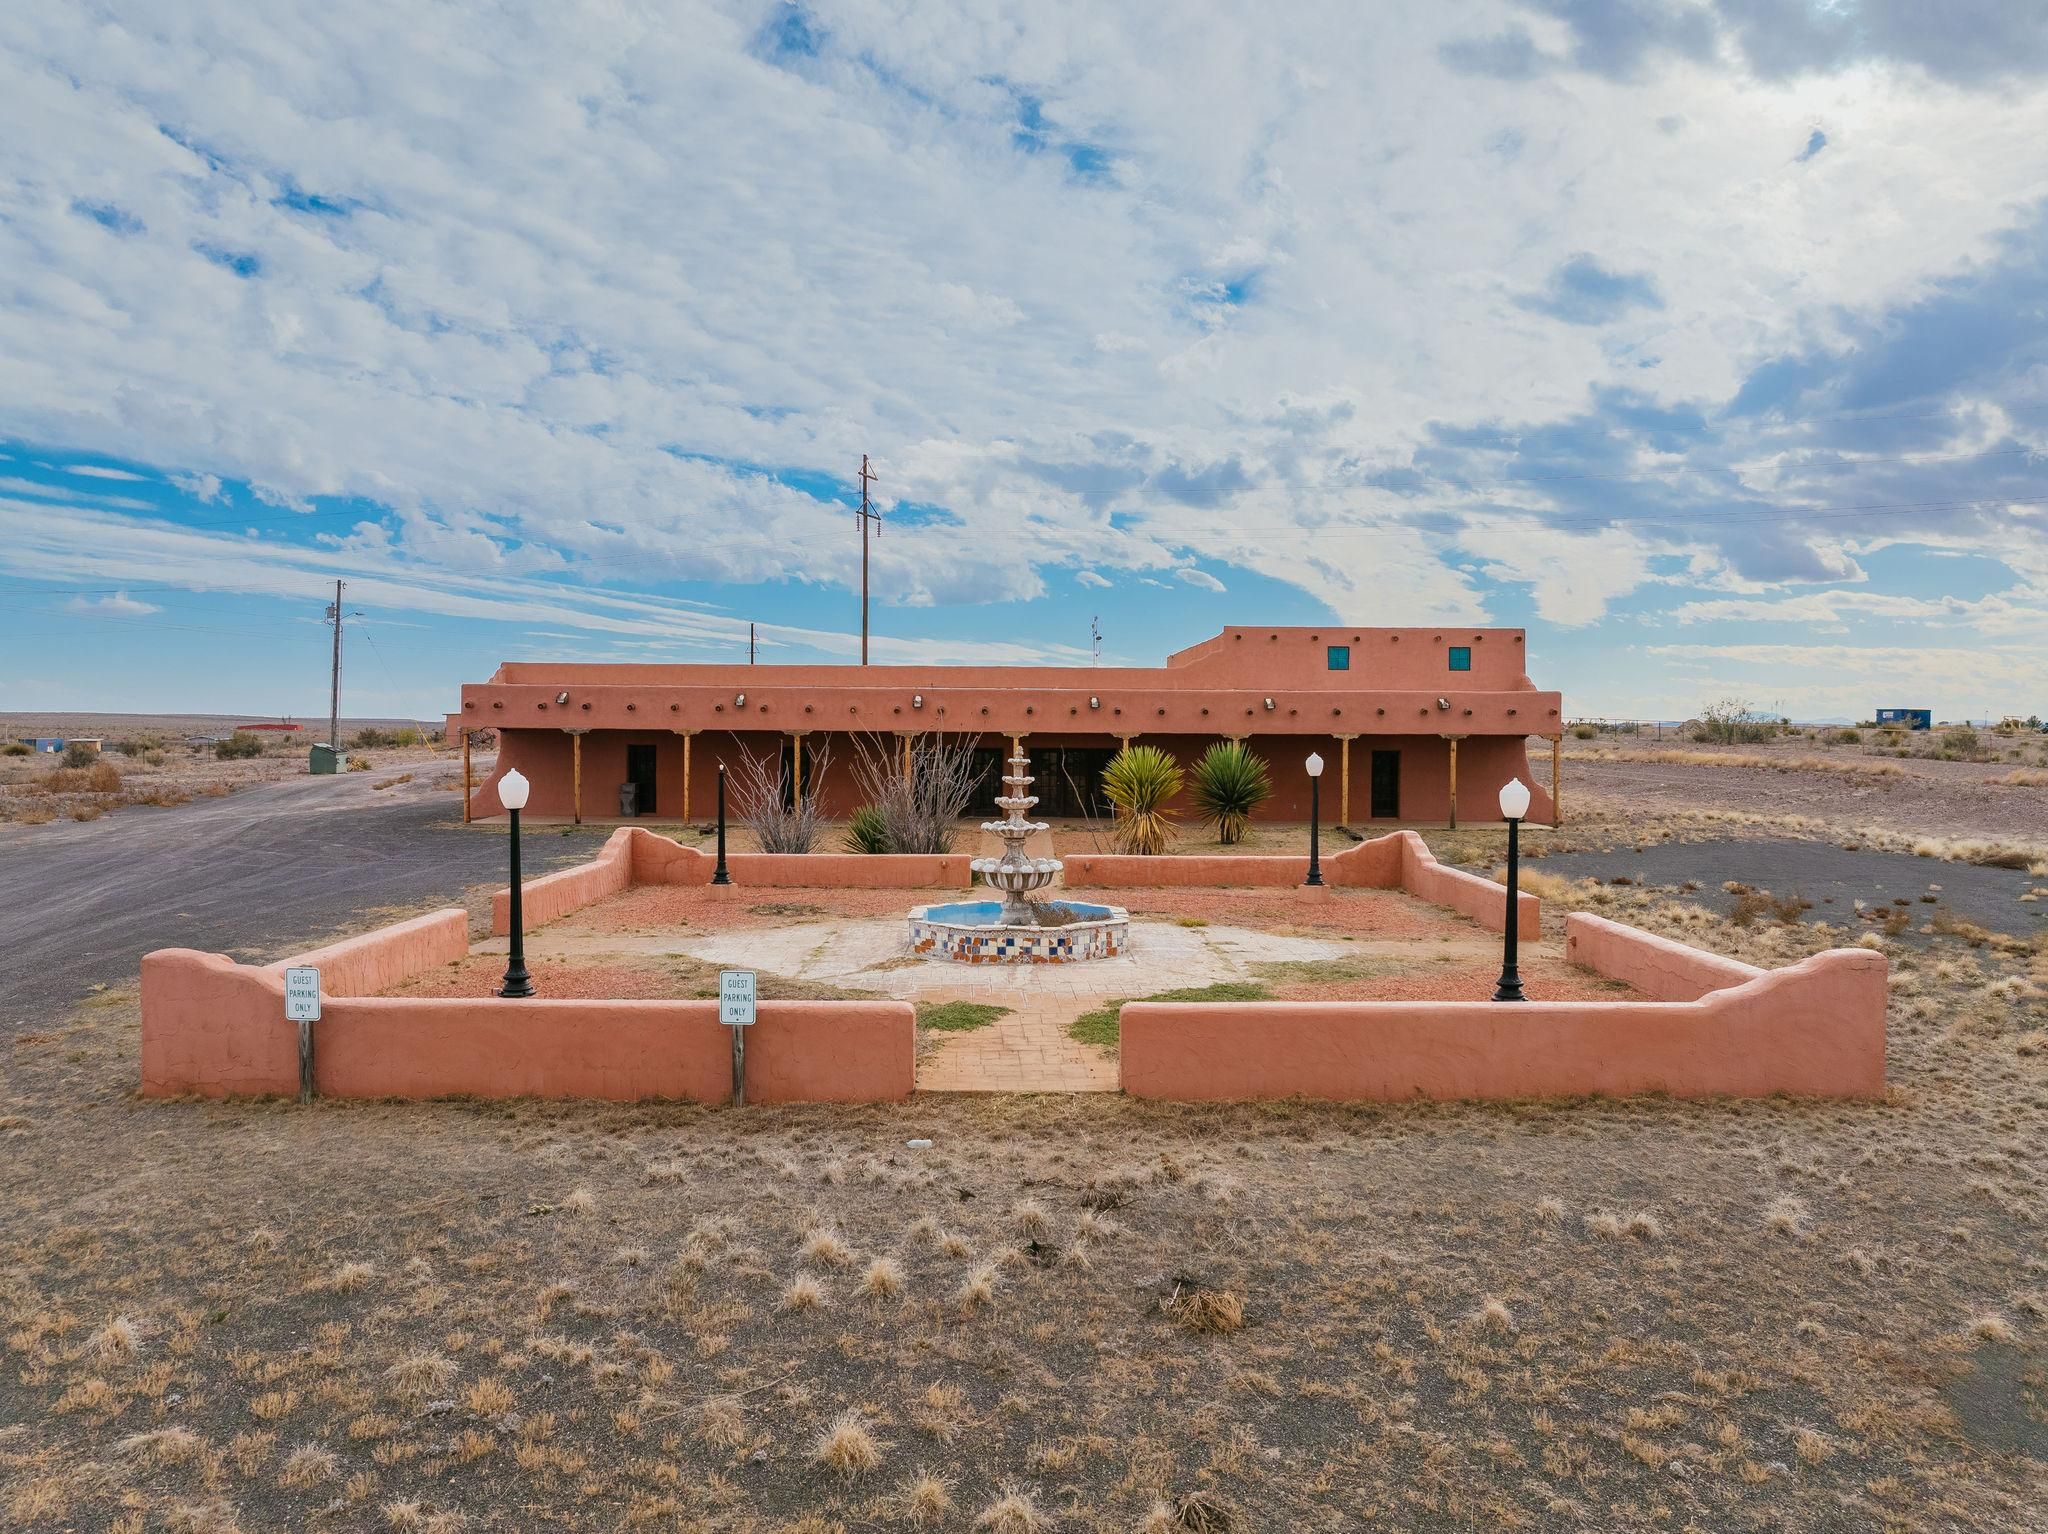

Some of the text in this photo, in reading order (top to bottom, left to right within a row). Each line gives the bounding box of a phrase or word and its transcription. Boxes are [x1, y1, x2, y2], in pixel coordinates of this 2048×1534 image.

[292, 975, 312, 985] GUEST
[728, 979, 748, 989] GUEST
[289, 989, 317, 999] PARKING
[723, 993, 752, 1003] PARKING
[294, 1003, 312, 1012] ONLY
[729, 1007, 747, 1016] ONLY
